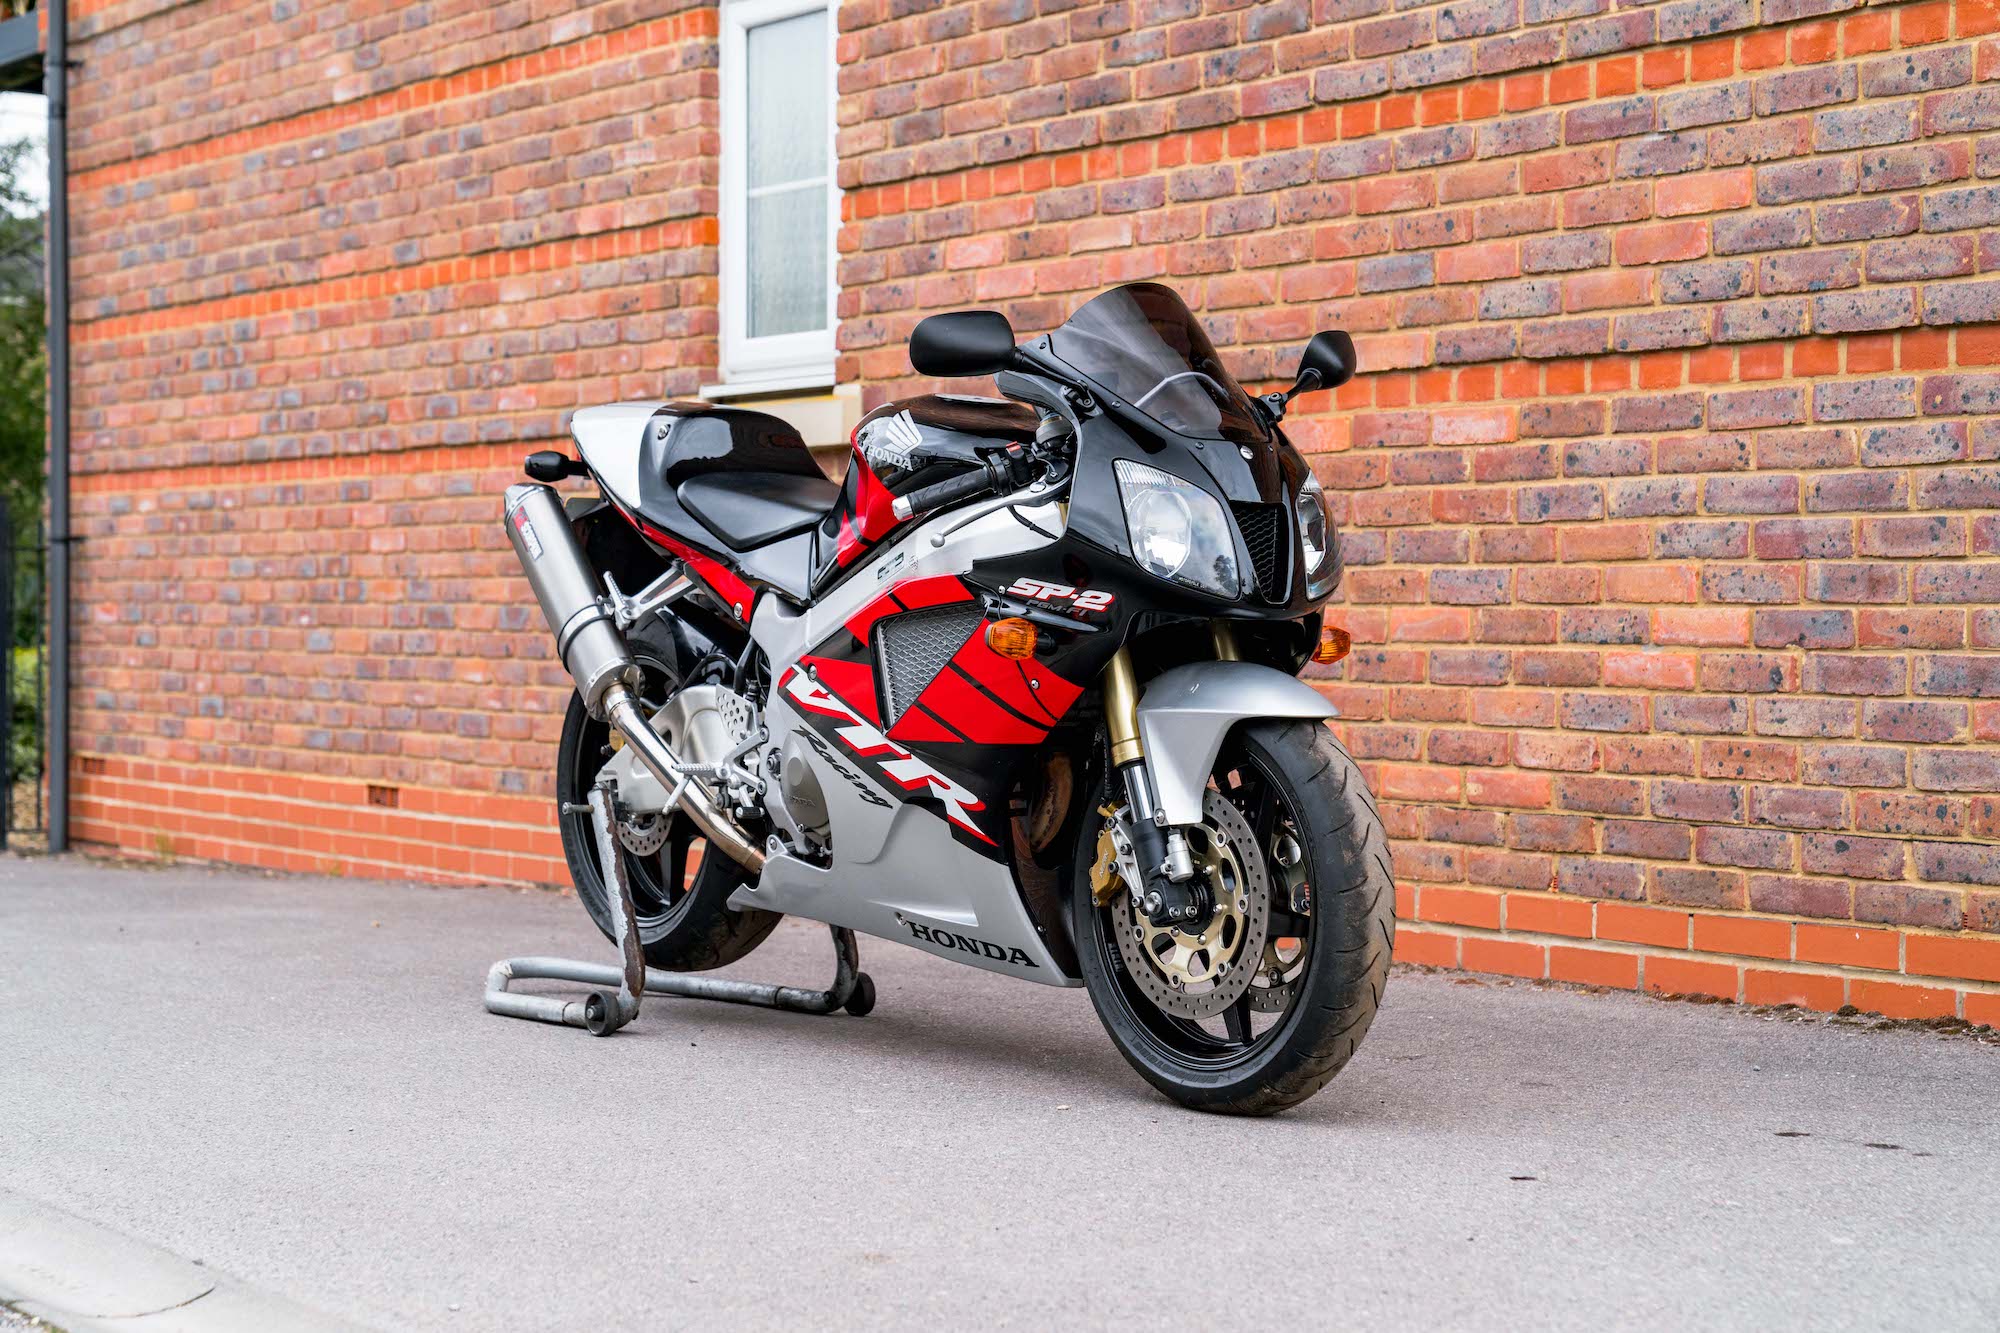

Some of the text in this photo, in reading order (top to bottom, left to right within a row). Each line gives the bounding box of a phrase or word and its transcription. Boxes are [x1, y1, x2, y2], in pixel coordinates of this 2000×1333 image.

[866, 445, 914, 471] HONDA
[1007, 577, 1115, 612] SP-2
[1026, 599, 1088, 616] PGM-FI
[785, 663, 998, 846] VTR
[791, 725, 893, 809] Racing
[905, 919, 1040, 968] HONDA
